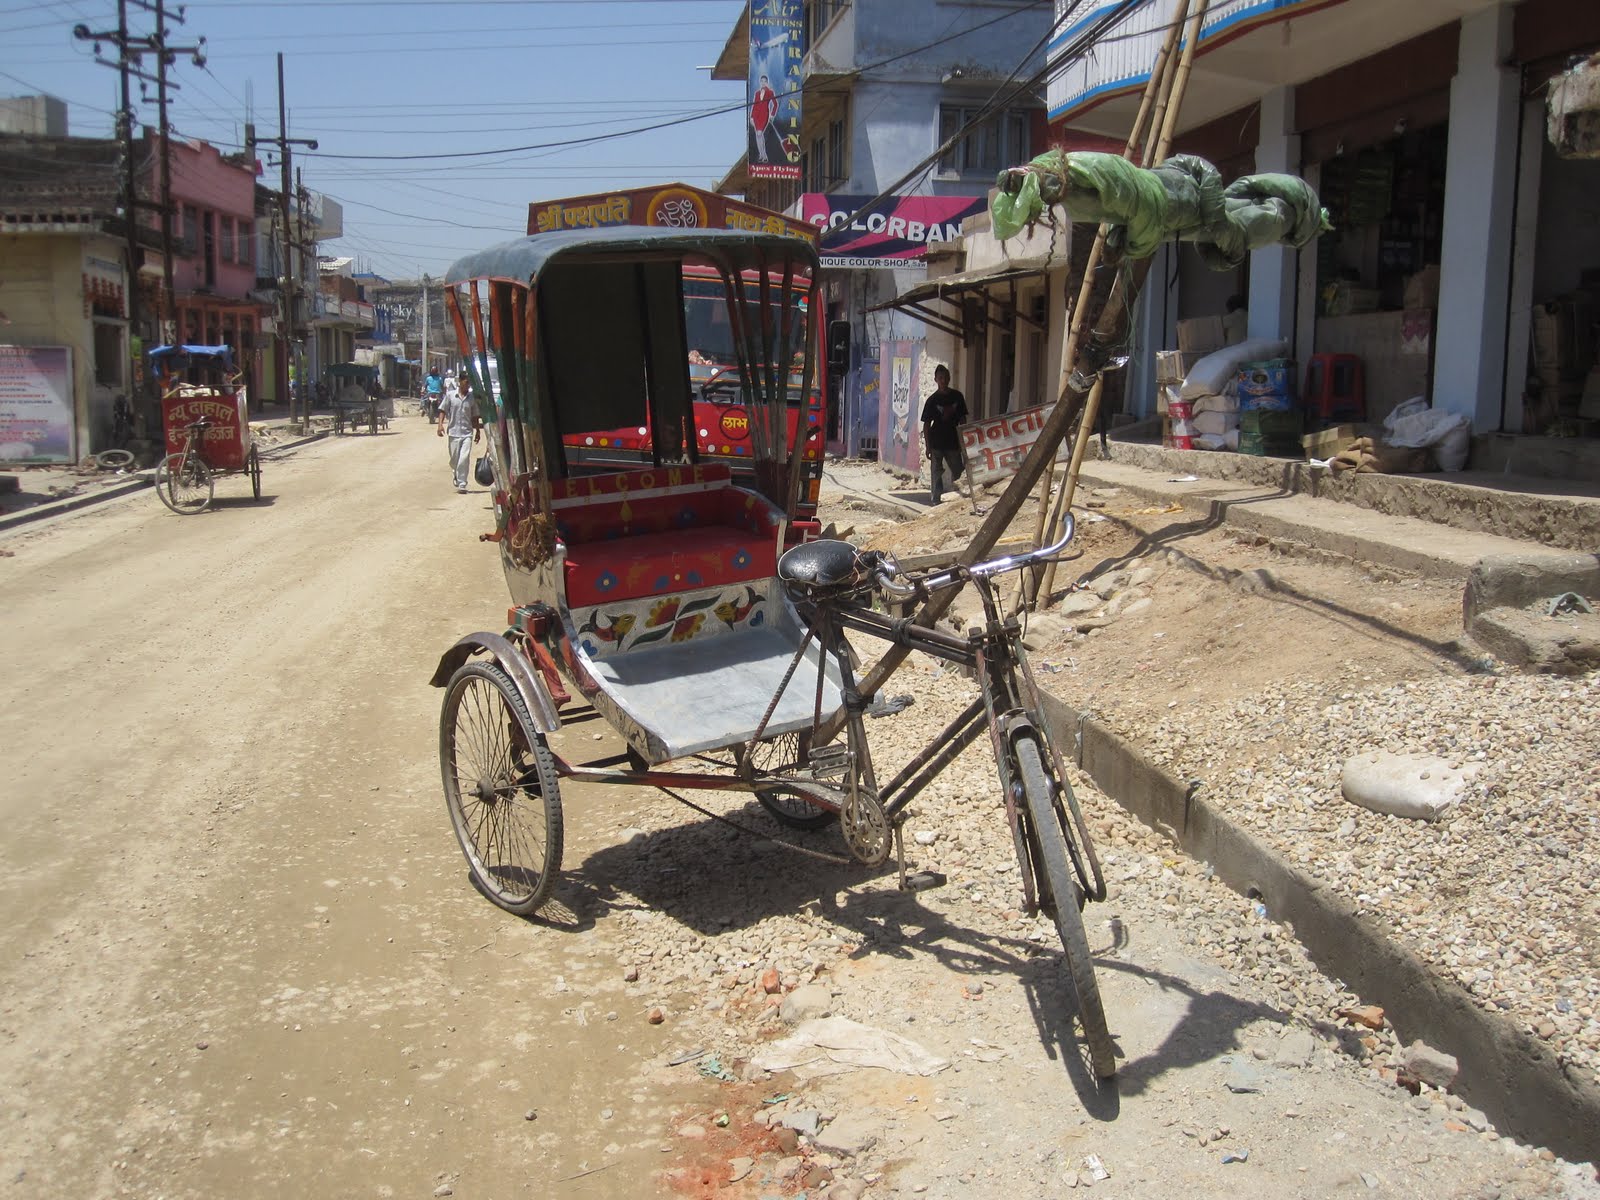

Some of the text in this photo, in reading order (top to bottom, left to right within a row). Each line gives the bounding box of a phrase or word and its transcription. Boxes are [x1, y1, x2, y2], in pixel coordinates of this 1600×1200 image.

[754, 0, 799, 16] Air
[787, 29, 802, 163] TRAINING
[809, 210, 962, 243] COLORBAN
[819, 258, 846, 266] NIQUE
[849, 259, 880, 267] COLOR
[723, 416, 748, 430] लाभ
[549, 464, 705, 498] ELCOME
